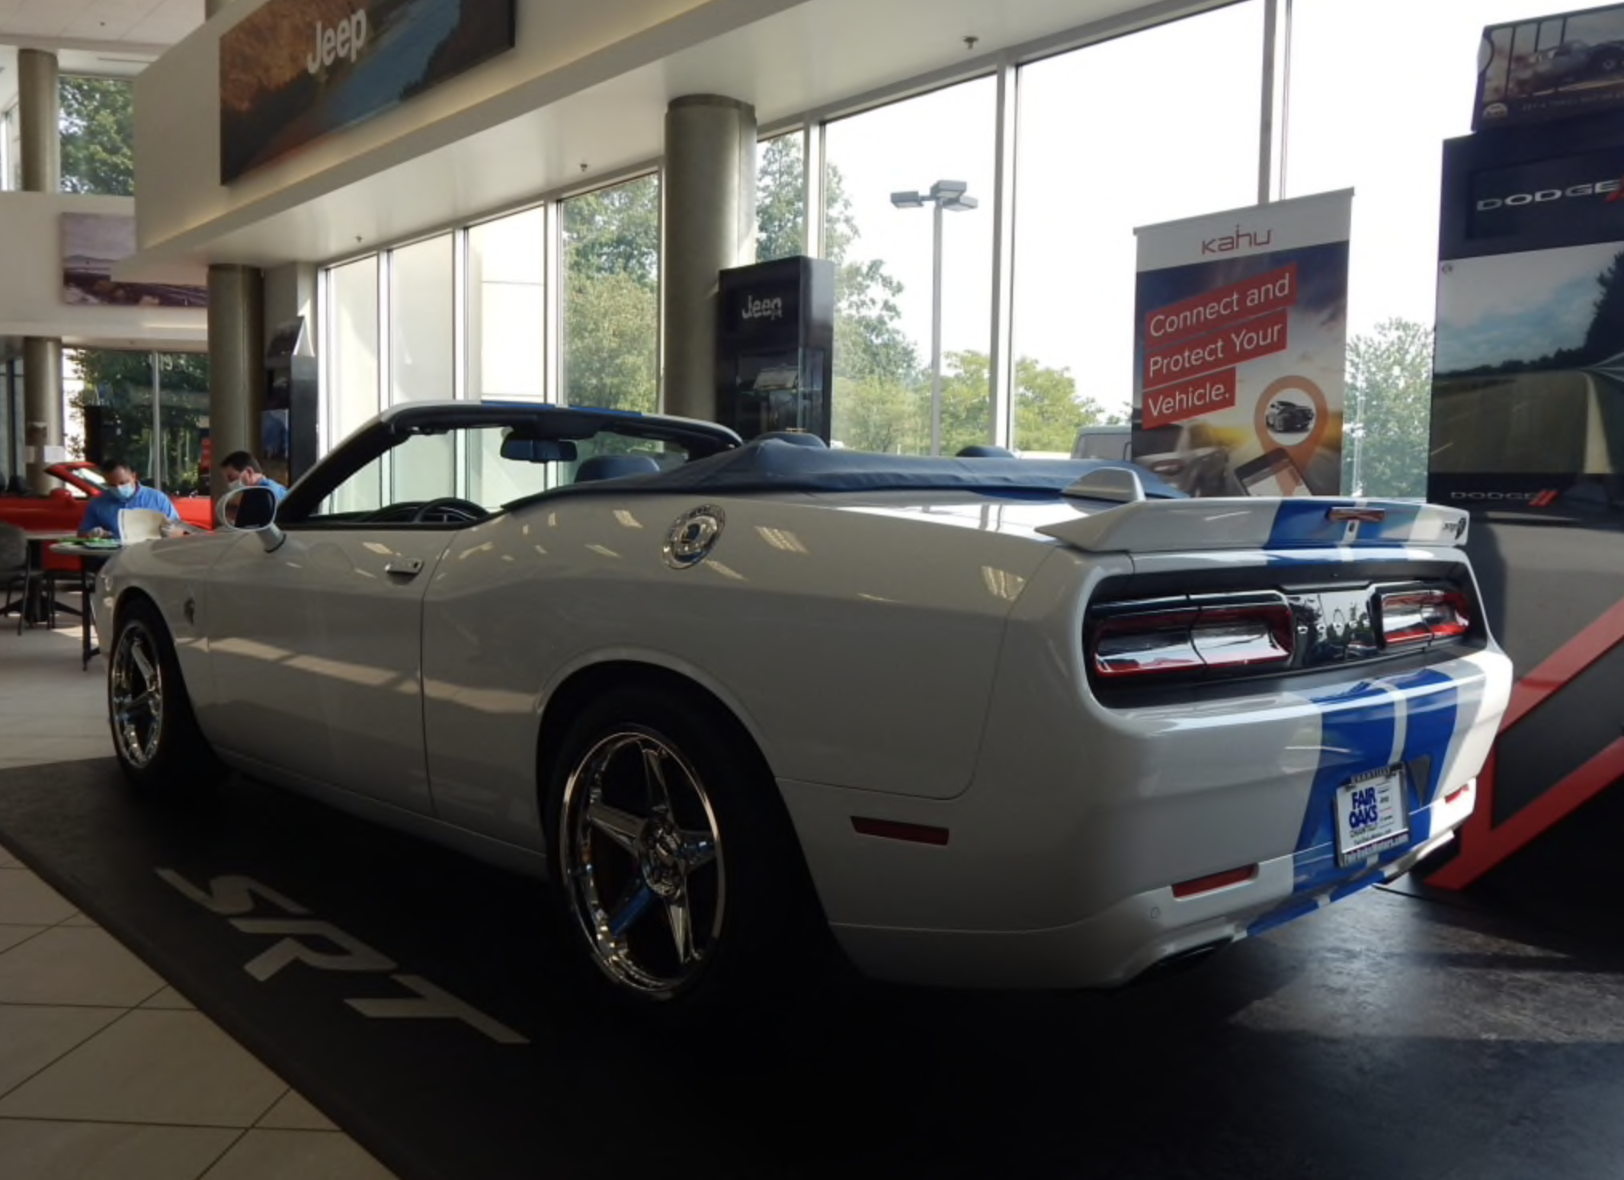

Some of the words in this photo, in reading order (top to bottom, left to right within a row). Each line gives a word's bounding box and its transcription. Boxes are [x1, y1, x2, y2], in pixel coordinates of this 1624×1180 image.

[306, 8, 367, 75] Jeep
[1476, 179, 1621, 211] DODGE
[1201, 222, 1274, 255] kahu
[741, 294, 783, 321] Jeep
[1150, 291, 1240, 337] Connect
[1246, 272, 1290, 306] and
[1149, 339, 1225, 379] Protect
[1231, 322, 1284, 353] Your
[1148, 382, 1231, 418] Vehicle.
[1352, 787, 1377, 810] FAIR
[1348, 805, 1378, 828] OAKS
[154, 868, 532, 1044] SRT
